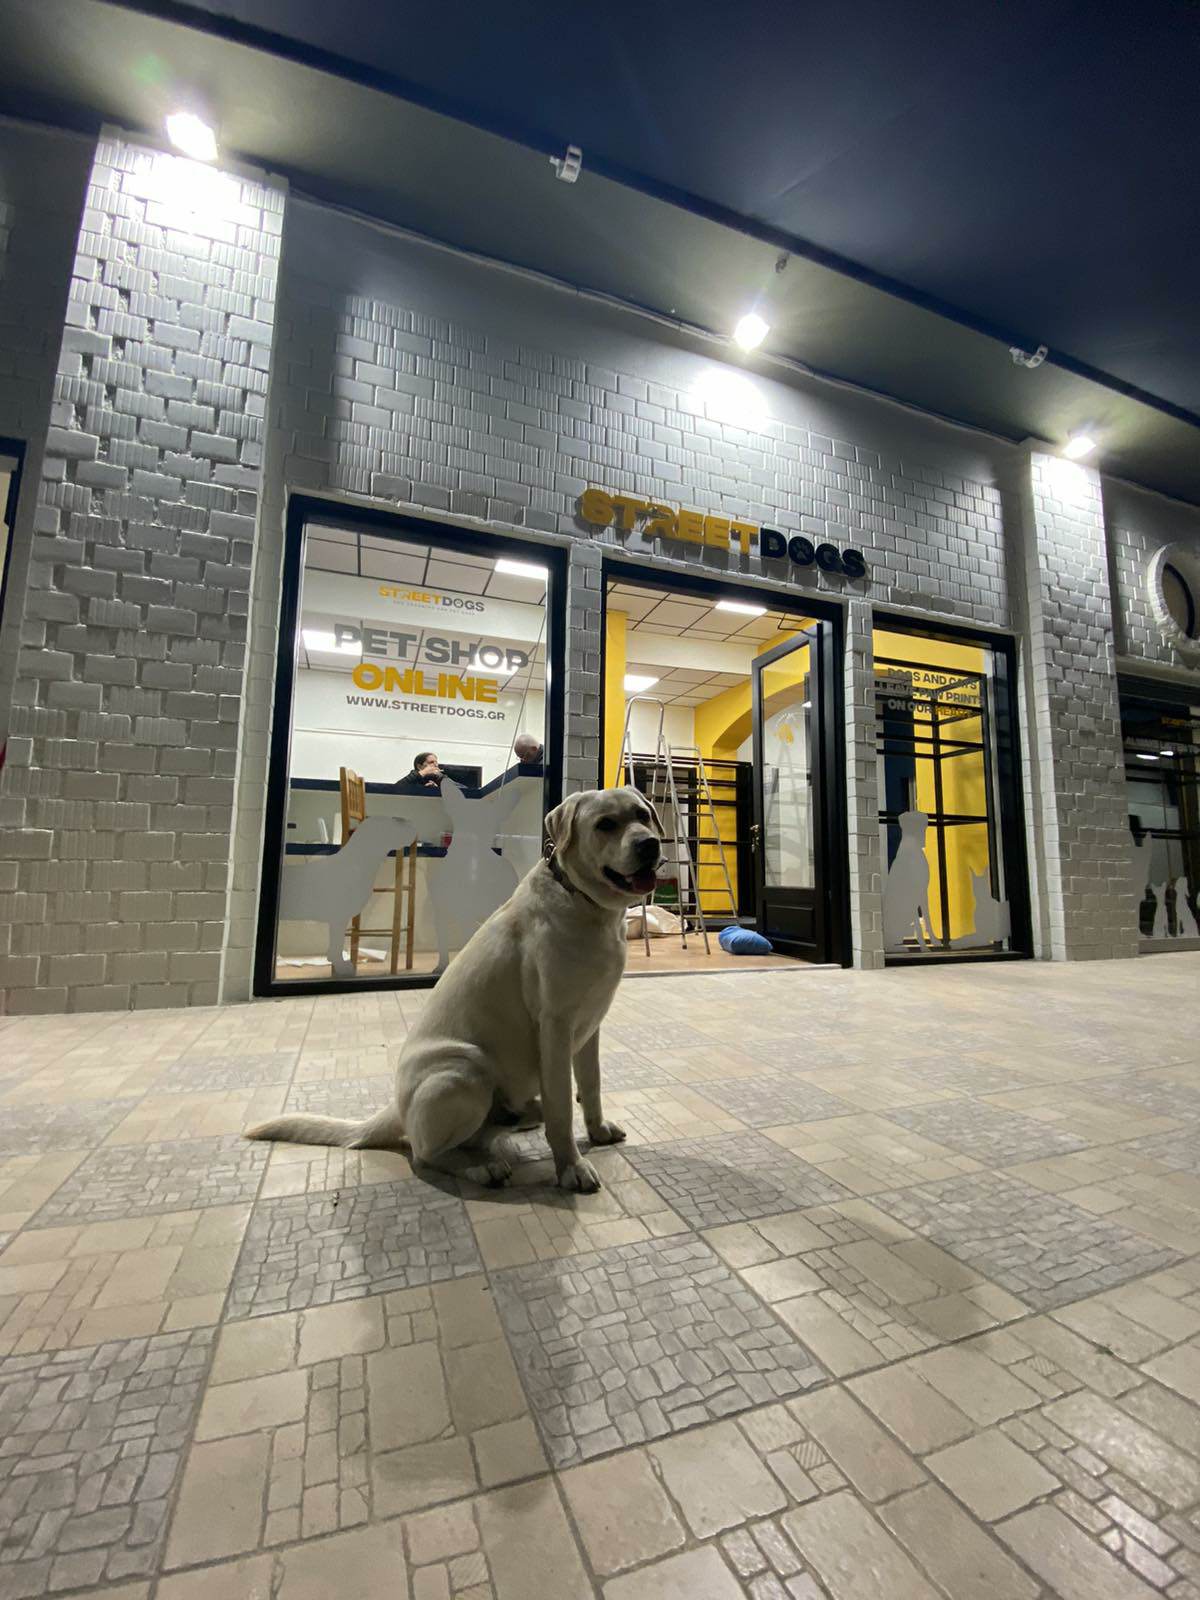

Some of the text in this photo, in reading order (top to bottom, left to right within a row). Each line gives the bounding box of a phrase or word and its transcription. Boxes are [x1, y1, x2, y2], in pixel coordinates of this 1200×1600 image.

[579, 488, 866, 577] STREETDOGS
[378, 585, 485, 613] STREETDOGS
[334, 623, 529, 671] PET SHOP
[352, 663, 498, 704] ONLINE
[923, 673, 947, 685] AND
[346, 695, 506, 721] WWW.STREETDOGS.GR
[887, 698, 907, 711] ON
[907, 701, 933, 715] OUR
